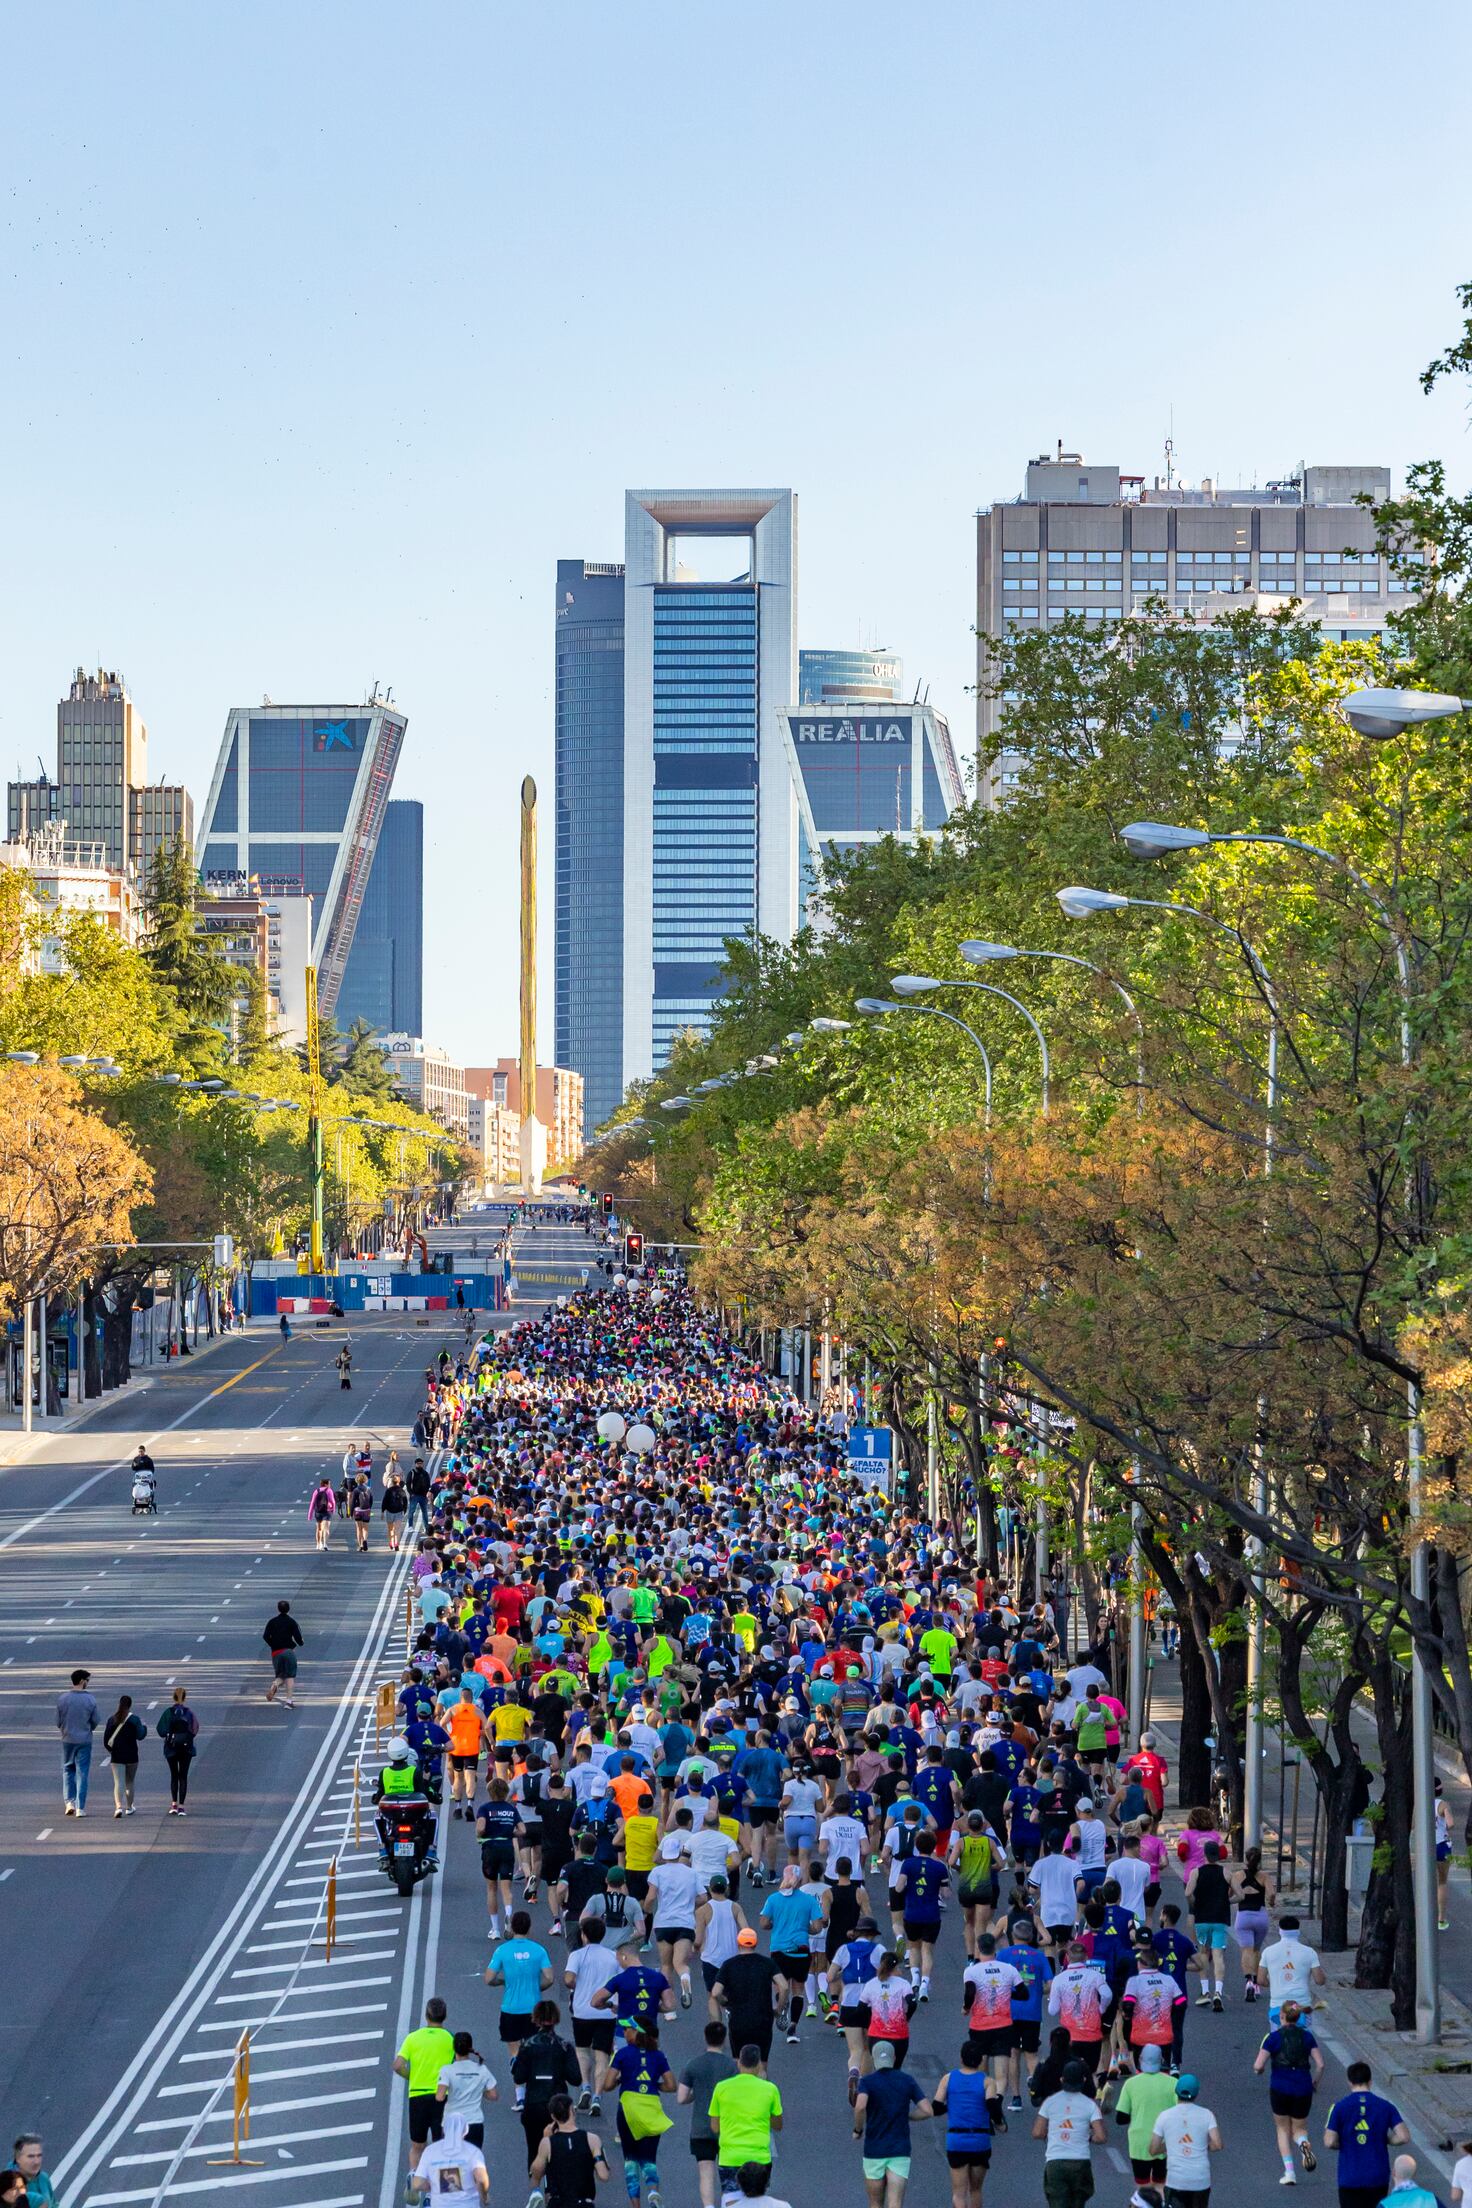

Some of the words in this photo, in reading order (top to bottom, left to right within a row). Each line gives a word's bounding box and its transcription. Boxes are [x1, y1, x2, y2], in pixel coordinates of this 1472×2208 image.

[799, 719, 905, 741] REALIA
[207, 869, 247, 880] KERN
[261, 877, 299, 886] Lenovo
[863, 1434, 875, 1456] 1
